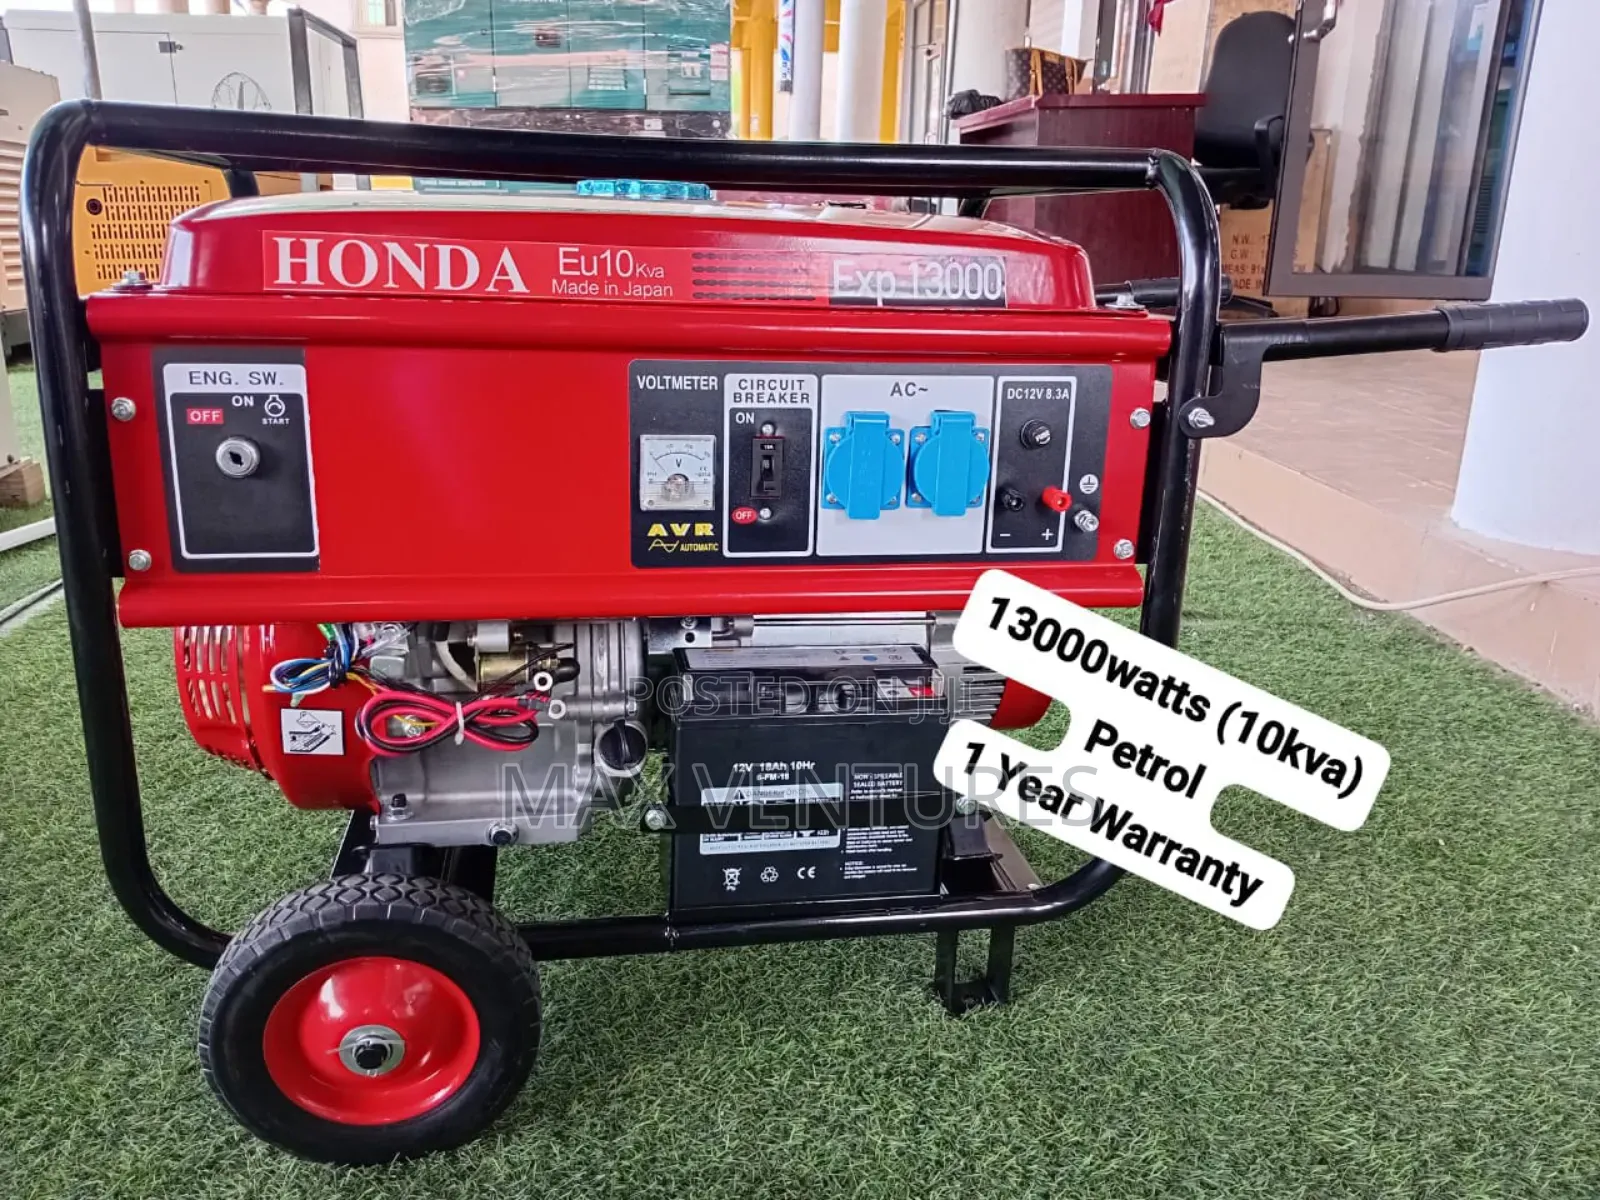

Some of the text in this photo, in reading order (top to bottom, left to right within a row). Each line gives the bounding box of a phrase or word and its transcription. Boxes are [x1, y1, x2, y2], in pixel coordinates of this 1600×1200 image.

[272, 235, 530, 294] HONDA
[551, 278, 674, 298] Made in Japan
[832, 258, 1002, 307] Exp 13000
[1233, 278, 1251, 290] ADE
[188, 370, 284, 386] ENG. SW.
[636, 374, 719, 391] VOLTMETER
[738, 379, 805, 391] CIRCUIT
[231, 394, 255, 407] ON
[733, 392, 810, 404] BREAKER
[1006, 388, 1070, 401] DC12V 8.3A
[189, 410, 221, 422] OFF
[261, 417, 290, 425] START
[735, 412, 755, 424] ON
[675, 458, 682, 468] V
[735, 511, 753, 520] OFF
[647, 523, 715, 537] AVR
[680, 542, 719, 552] AUTOMATIC
[733, 762, 754, 773] 12V
[789, 760, 816, 770] 10Hr
